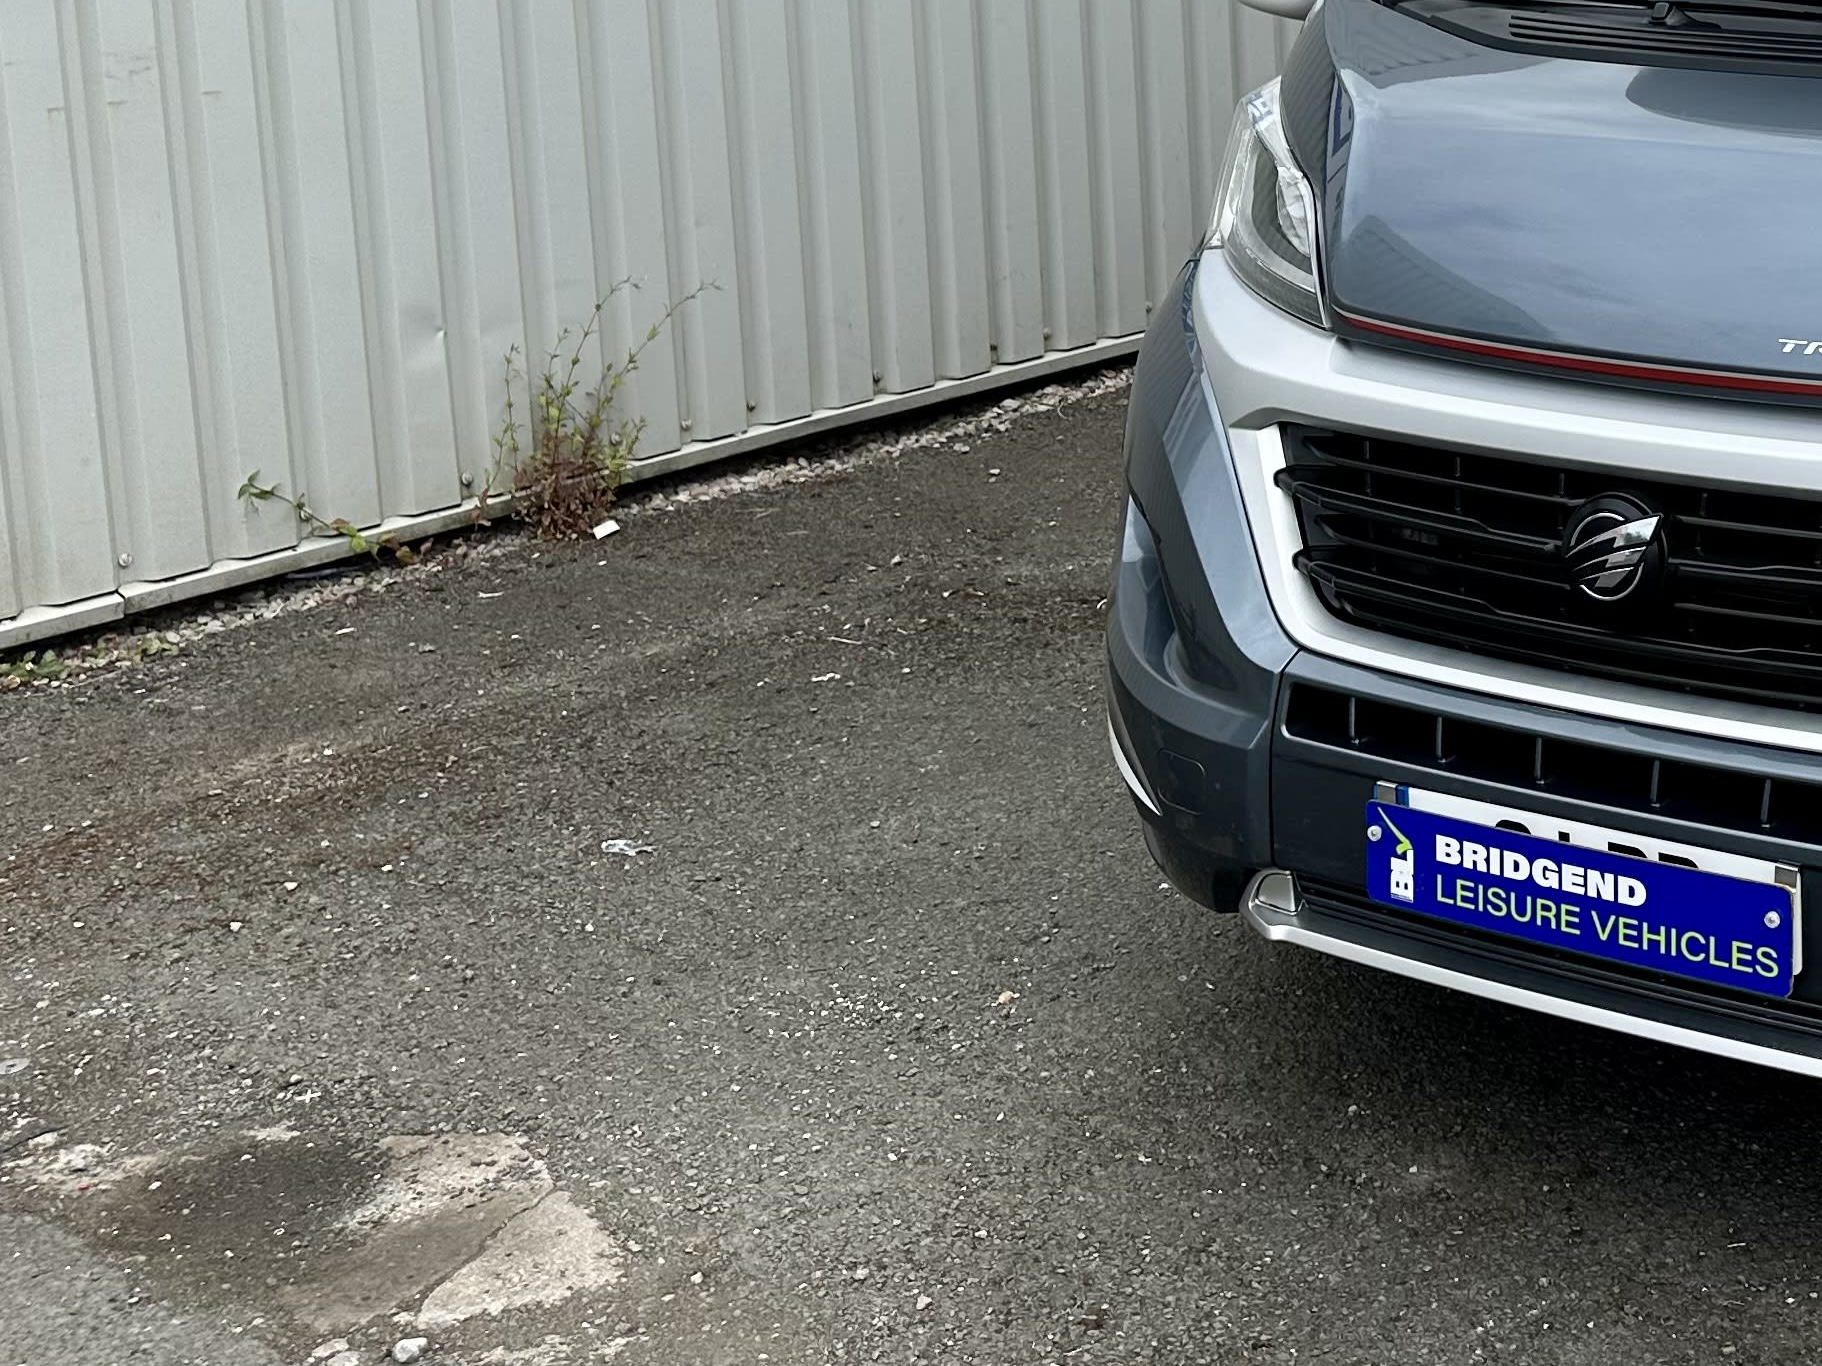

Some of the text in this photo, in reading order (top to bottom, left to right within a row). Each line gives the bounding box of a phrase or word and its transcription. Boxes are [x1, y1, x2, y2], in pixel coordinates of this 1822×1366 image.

[1435, 834, 1647, 907] BRIDGEND
[1436, 873, 1779, 979] LEISURE VEHICLES
